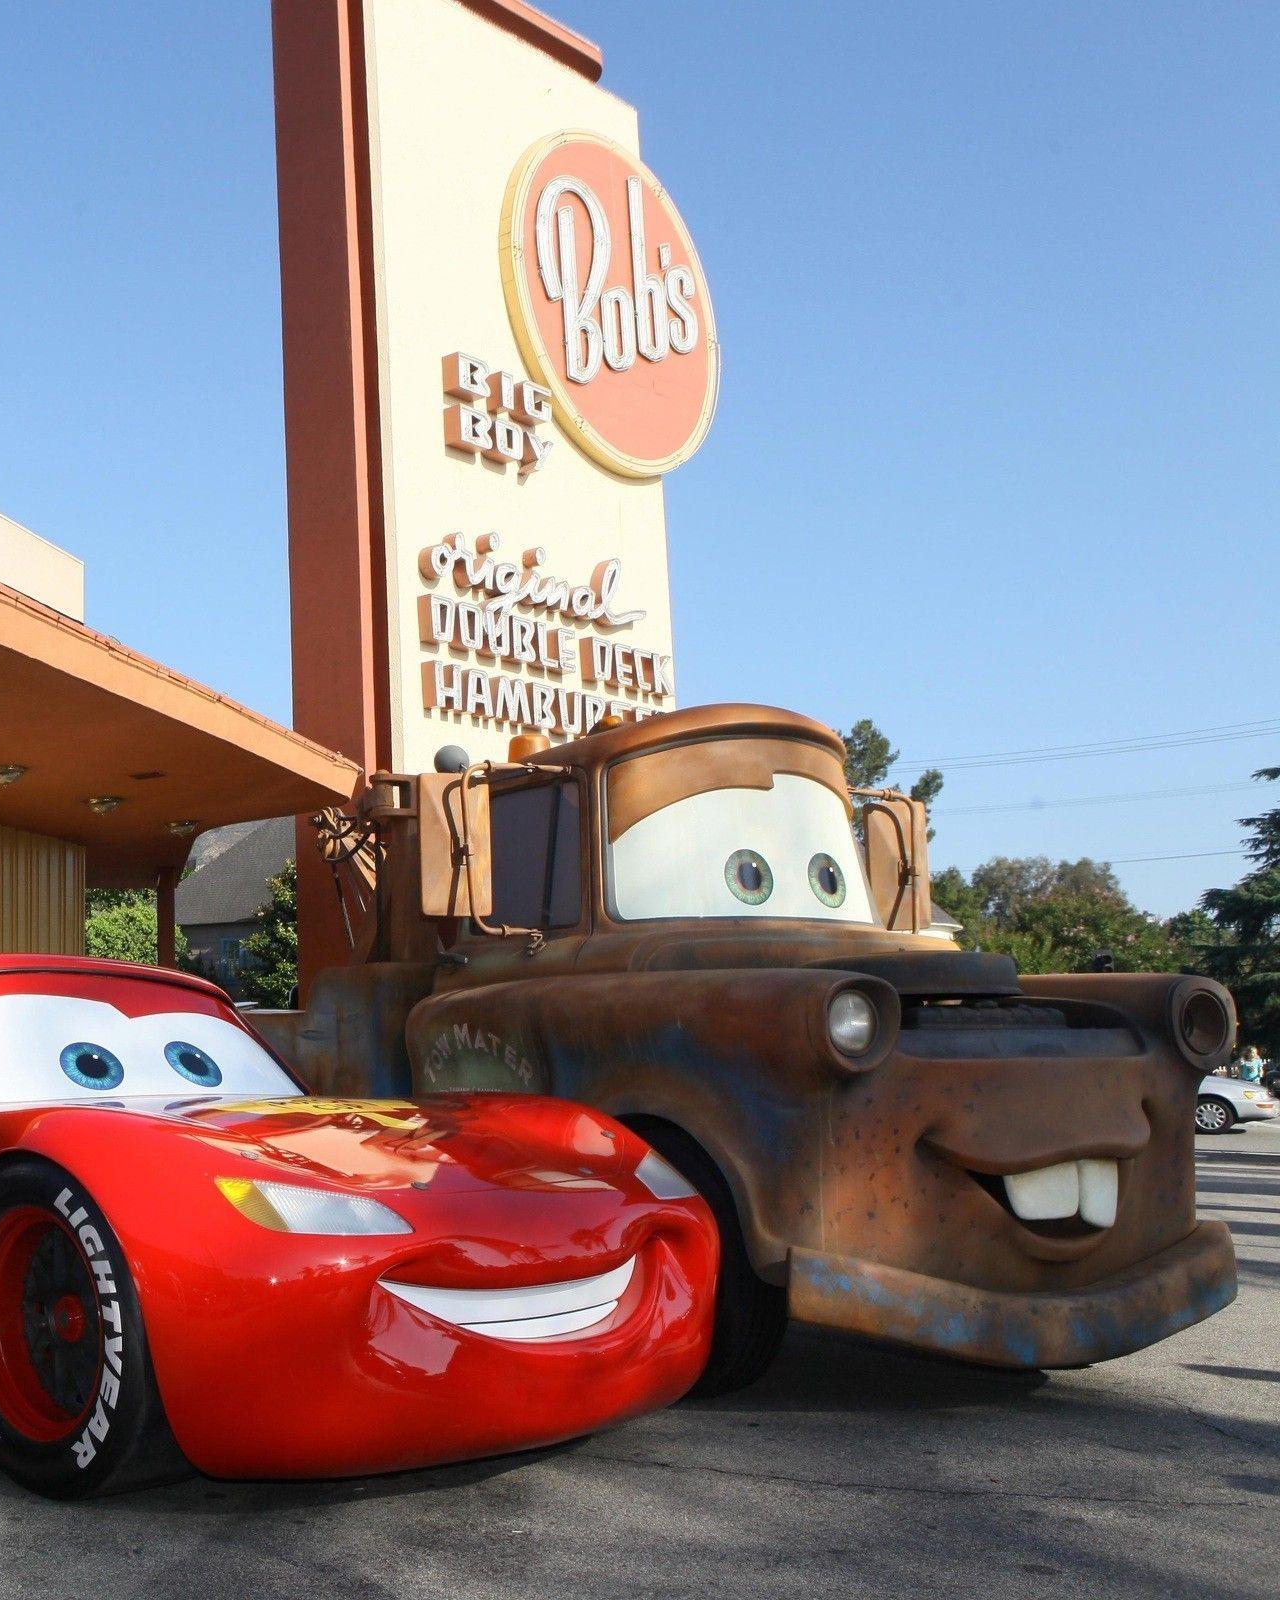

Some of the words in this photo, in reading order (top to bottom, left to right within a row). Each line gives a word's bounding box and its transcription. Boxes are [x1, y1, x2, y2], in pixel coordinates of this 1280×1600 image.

[535, 174, 700, 385] Bob's
[455, 352, 553, 425] BIG
[458, 404, 555, 477] BOY
[429, 531, 647, 638] original
[429, 594, 577, 673] DOUBLE
[590, 637, 676, 696] DECK
[434, 660, 666, 736] HAMBUR
[423, 1032, 452, 1084] TOW
[452, 1022, 535, 1088] MATER
[52, 1186, 123, 1470] LIGHTYEAR
